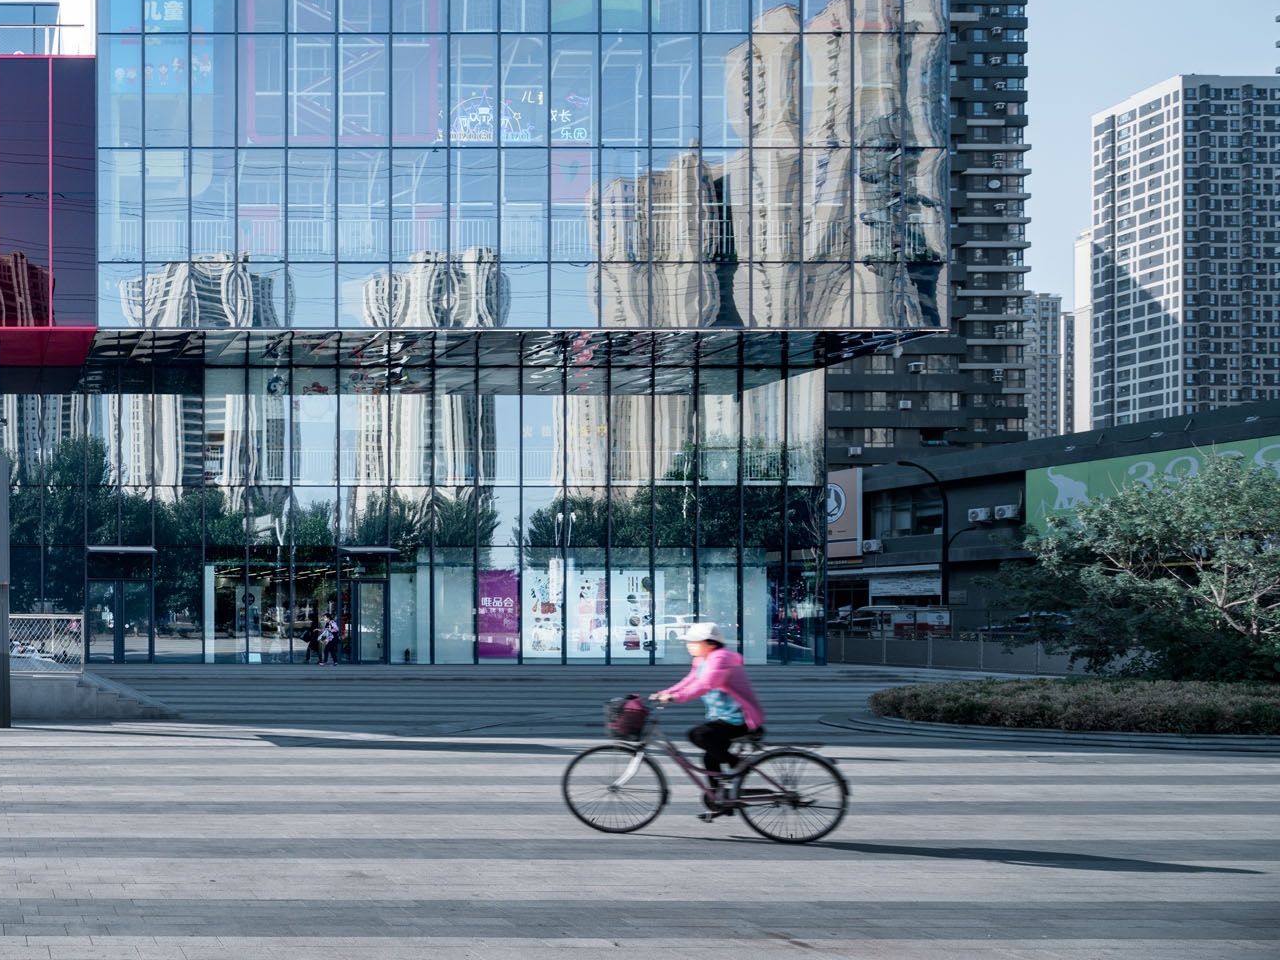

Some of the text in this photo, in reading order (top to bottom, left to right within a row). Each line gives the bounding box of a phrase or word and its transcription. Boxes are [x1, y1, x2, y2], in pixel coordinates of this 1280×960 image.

[144, 0, 184, 20] 儿童
[560, 127, 587, 141] 乐园
[481, 596, 514, 607] 唯品会
